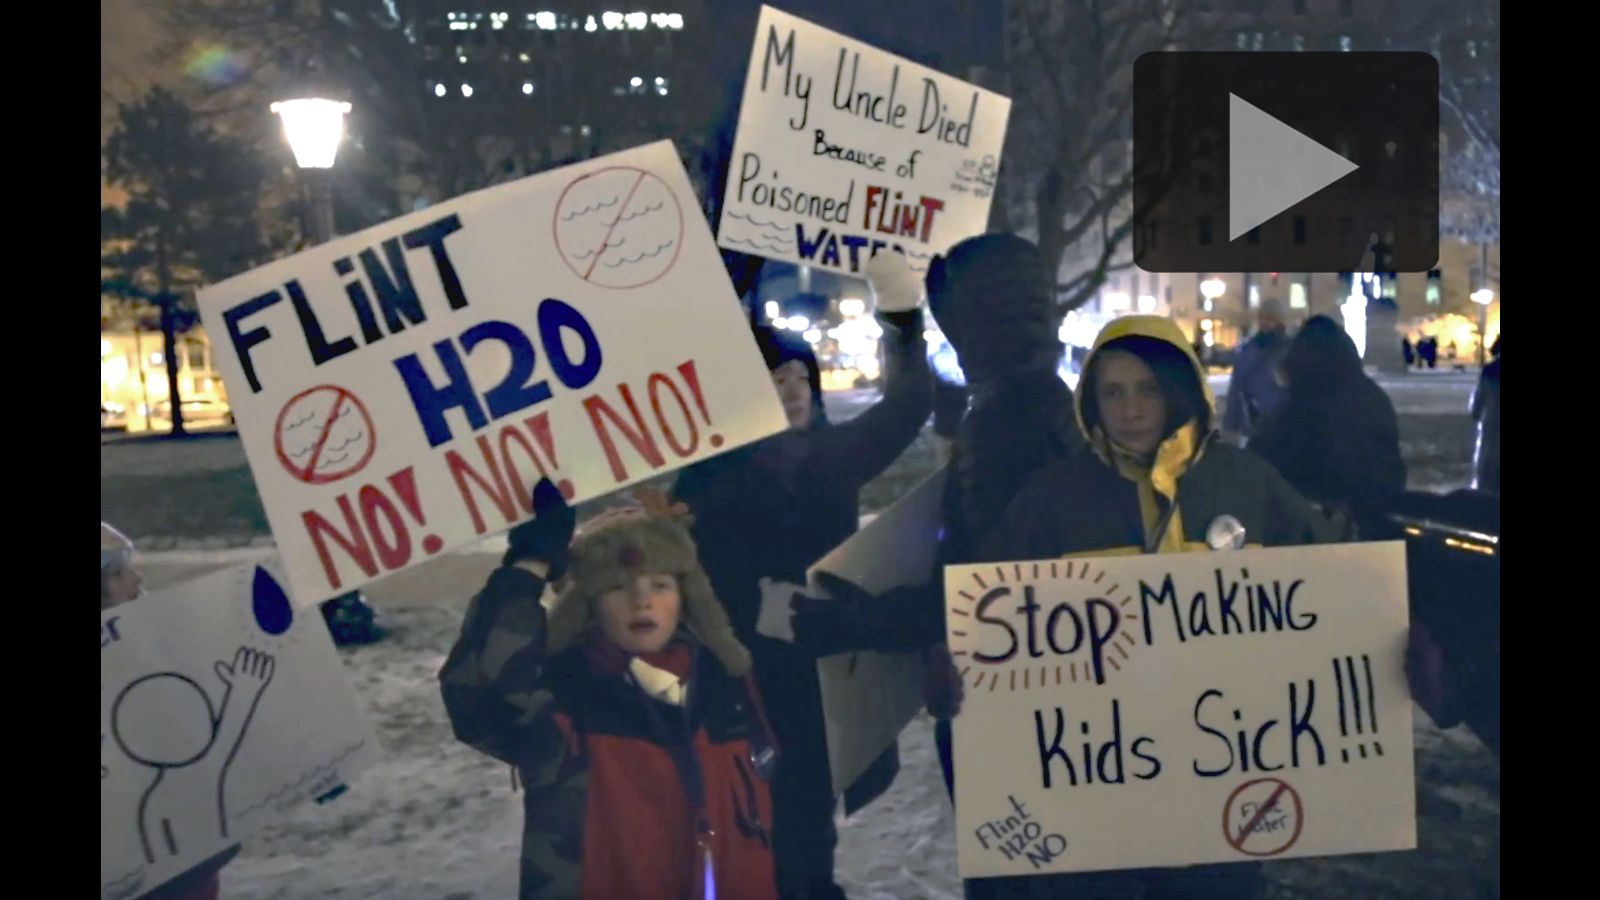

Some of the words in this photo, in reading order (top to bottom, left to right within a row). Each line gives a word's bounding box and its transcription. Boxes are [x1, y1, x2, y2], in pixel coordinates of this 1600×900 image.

[761, 24, 811, 131] My
[832, 47, 906, 129] Uncle
[917, 78, 979, 147] Died
[737, 153, 855, 224] Poisoned
[813, 129, 887, 172] Because
[896, 150, 922, 179] of
[796, 223, 906, 272] WAT
[301, 465, 444, 590] NO!
[444, 410, 575, 535] NO!
[583, 359, 724, 483] NO!
[972, 585, 1121, 685] Stop
[1034, 699, 1161, 788] Kids
[975, 795, 1031, 850] Flint
[1026, 833, 1067, 869] NO
